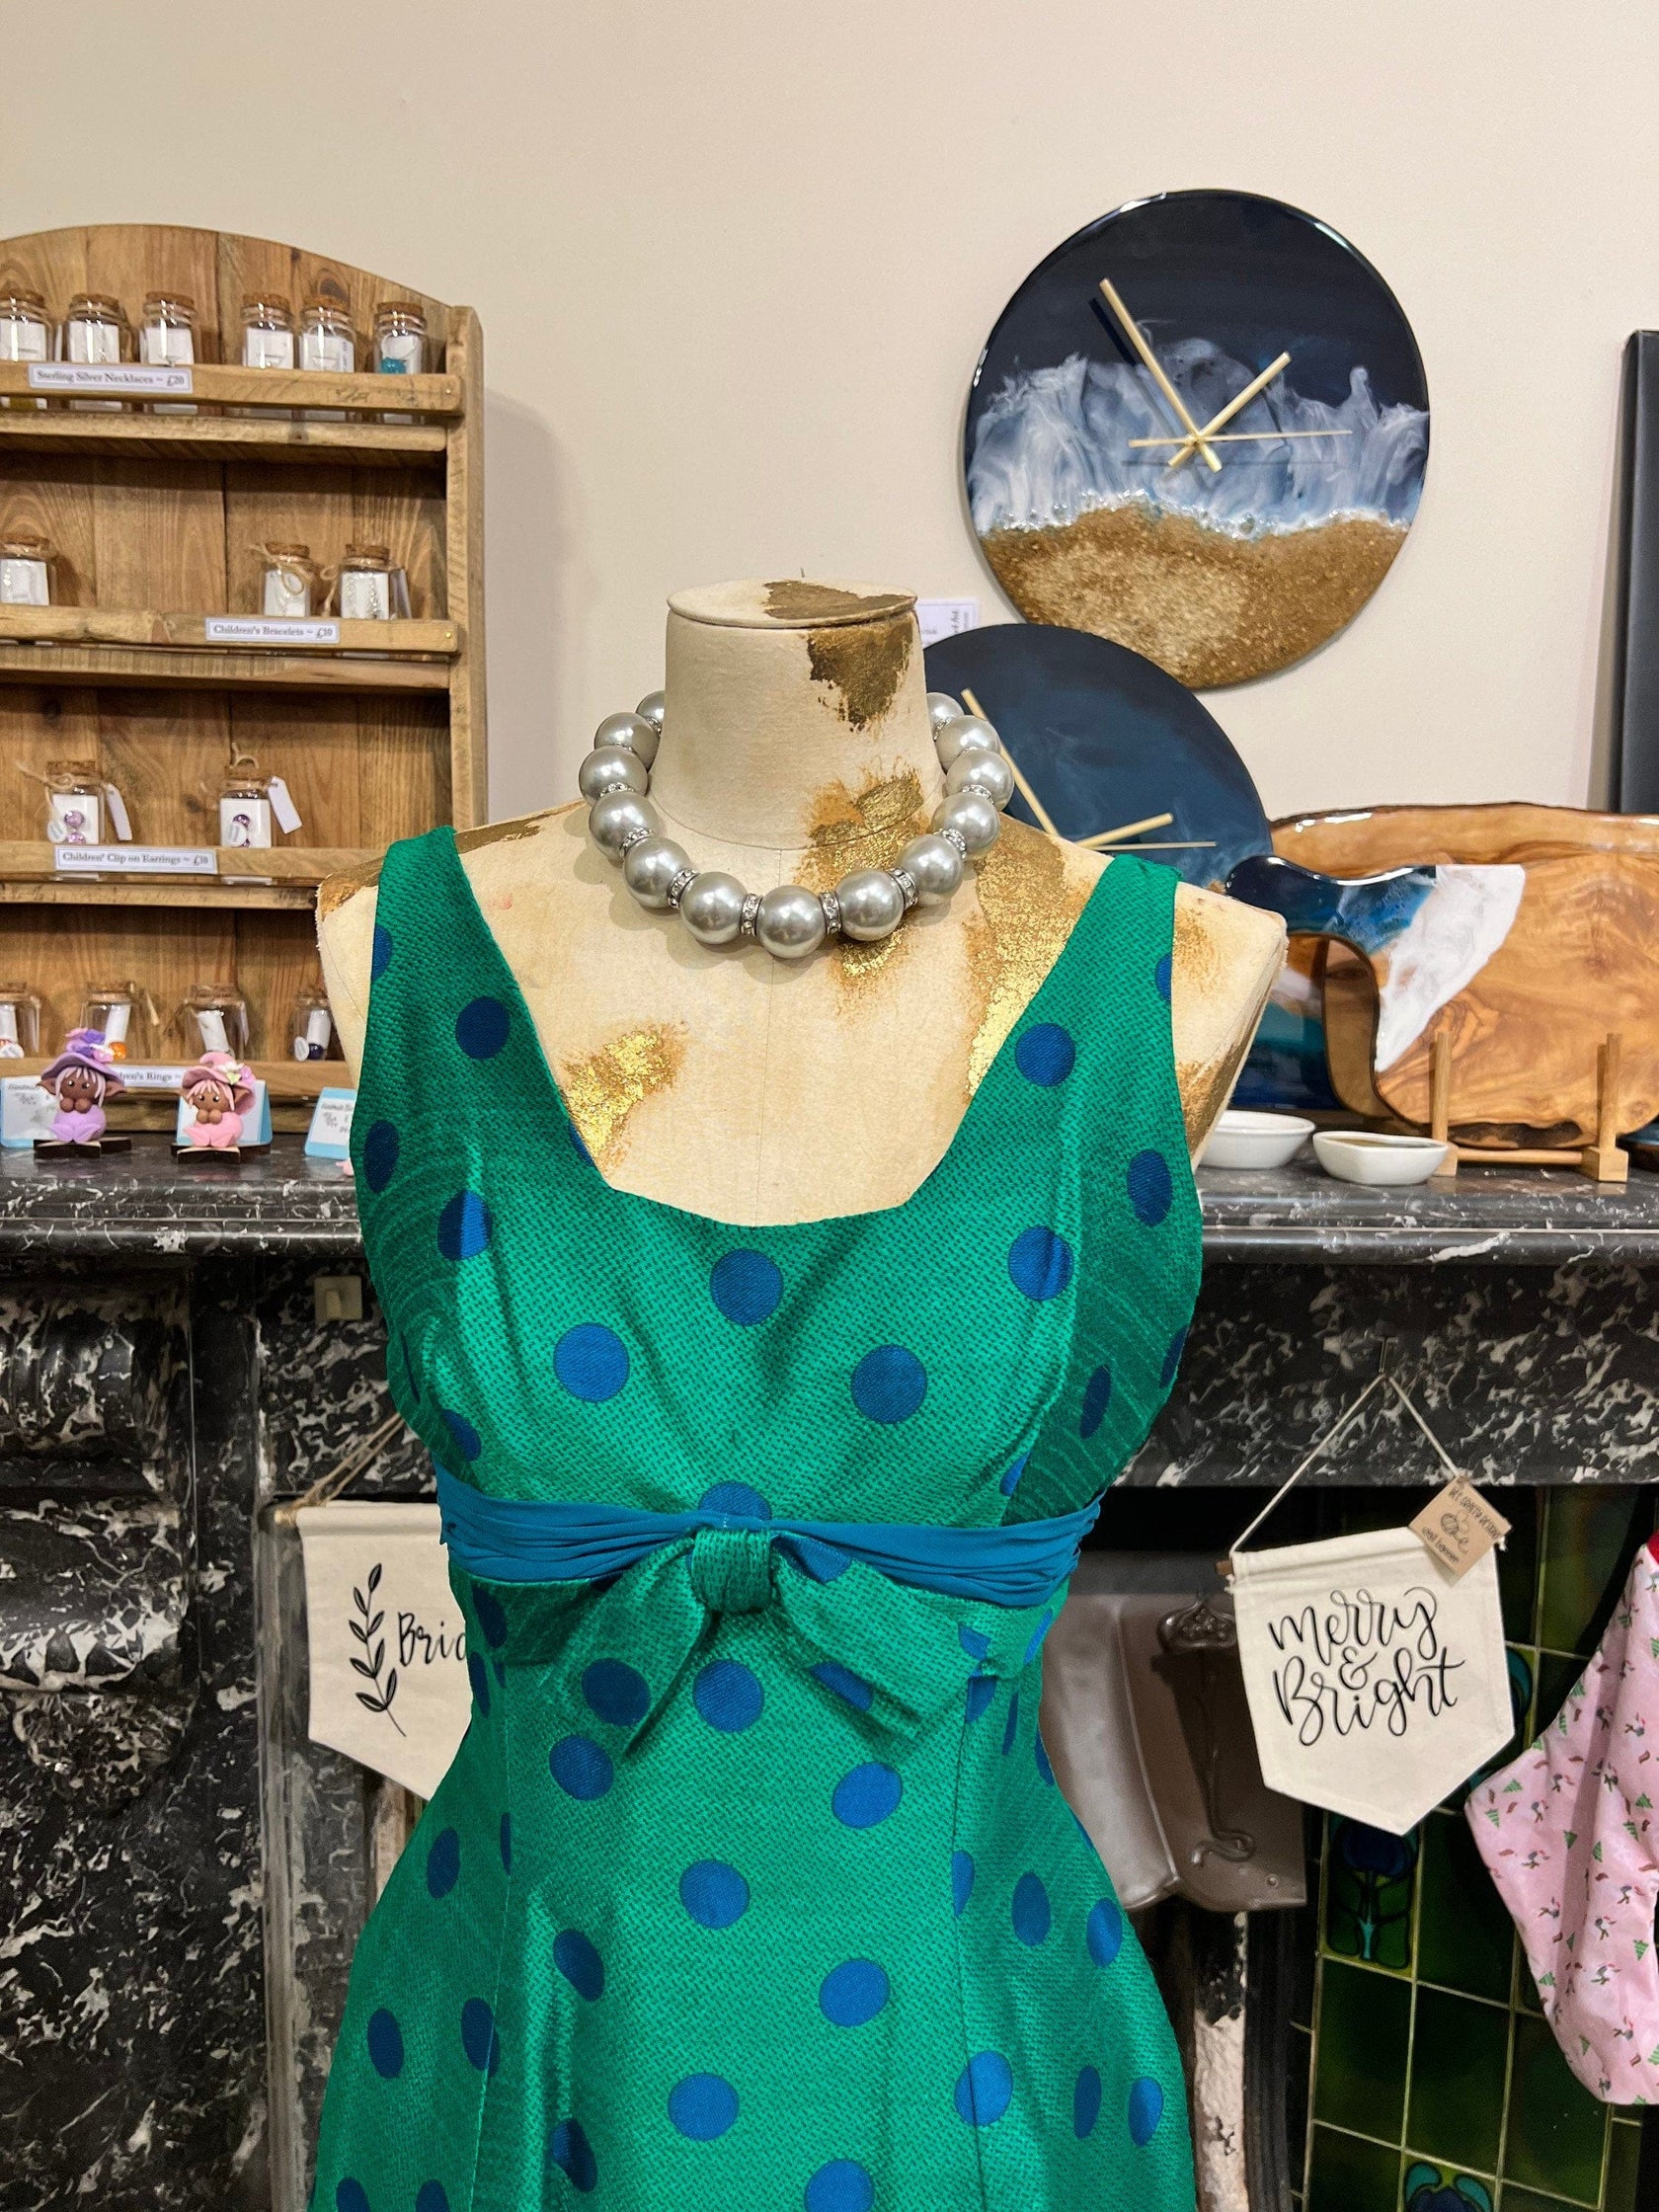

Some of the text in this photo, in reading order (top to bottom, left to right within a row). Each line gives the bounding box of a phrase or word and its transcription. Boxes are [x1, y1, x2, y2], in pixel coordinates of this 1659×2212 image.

[37, 369, 75, 383] Sterling
[76, 371, 103, 382] Silver
[105, 372, 154, 384] Necklaces
[213, 624, 261, 635] Children's
[263, 626, 304, 637] Bracelets
[107, 853, 125, 864] Clip
[142, 854, 182, 866] Earrings
[1337, 1645, 1378, 1691] &
[1273, 1646, 1466, 1747] Bright
